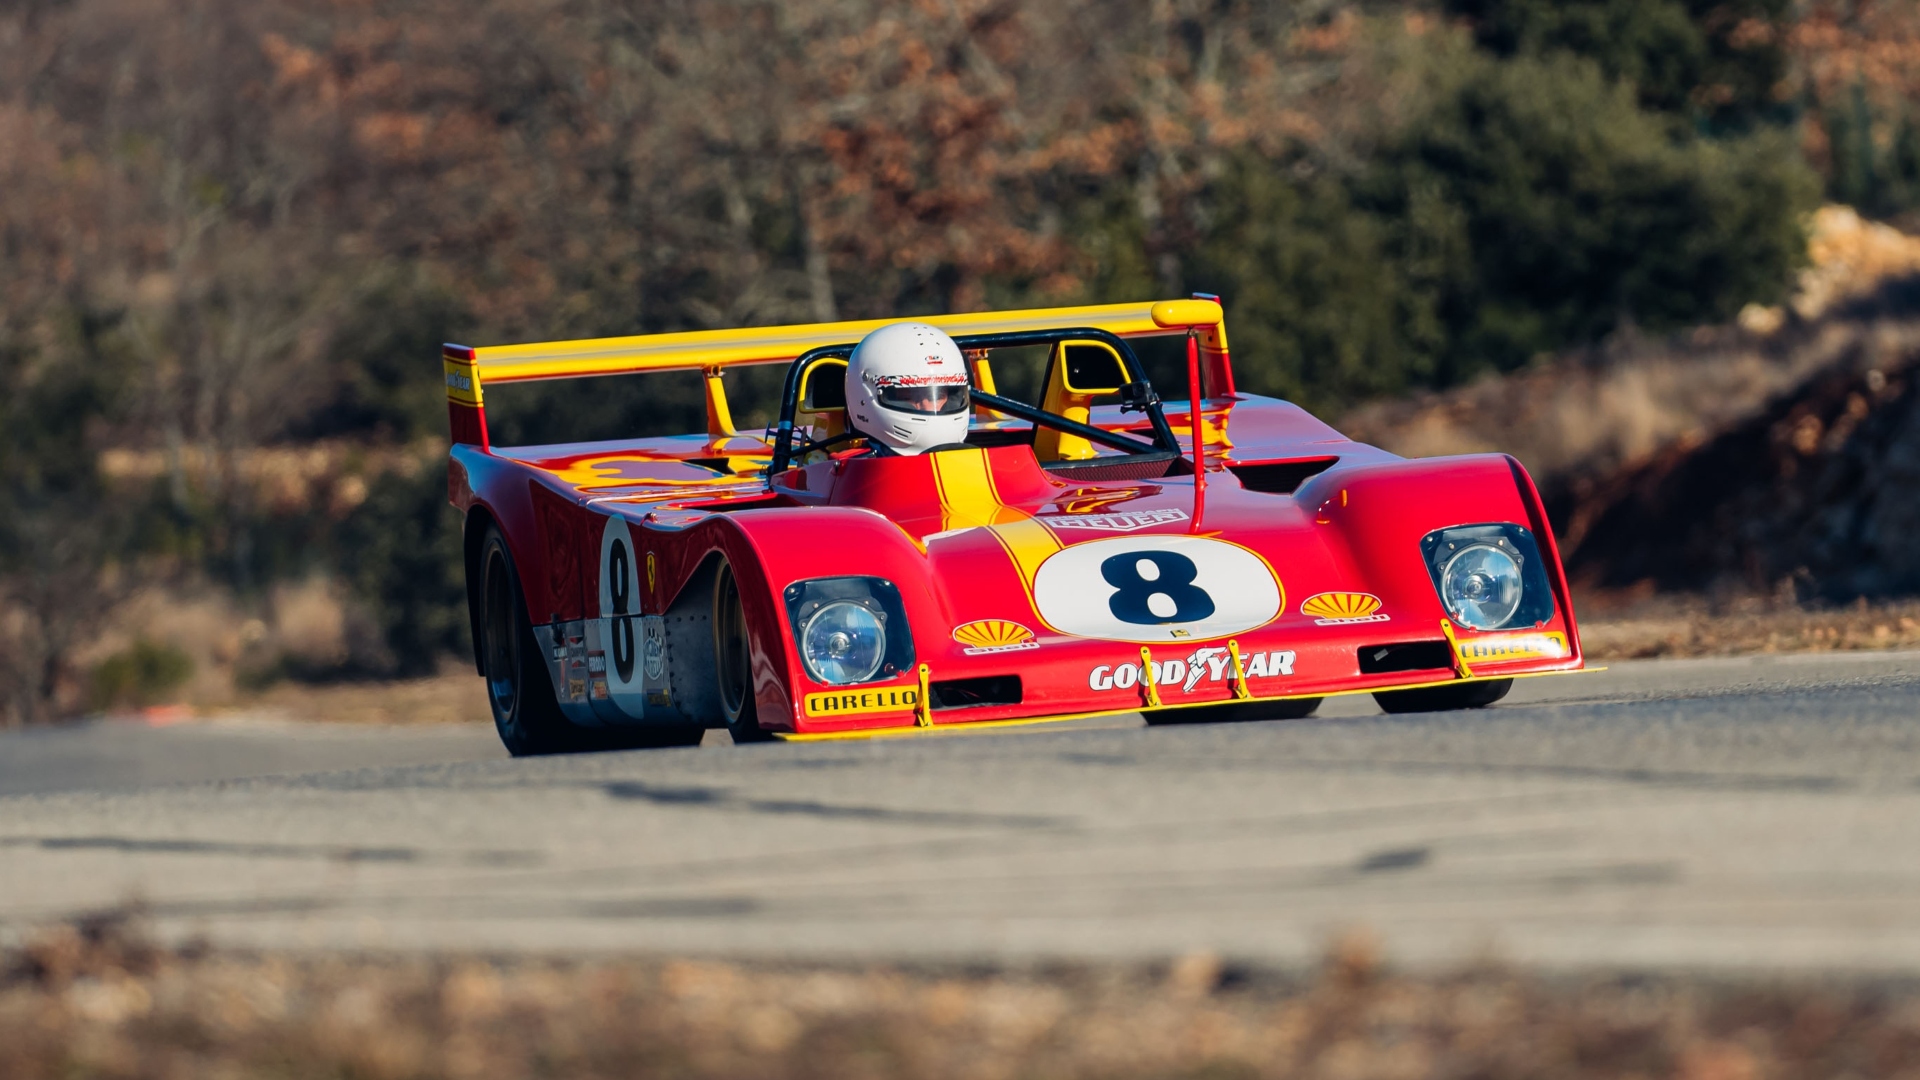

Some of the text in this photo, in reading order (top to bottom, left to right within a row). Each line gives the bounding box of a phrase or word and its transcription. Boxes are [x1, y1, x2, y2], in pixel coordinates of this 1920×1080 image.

[1059, 511, 1178, 529] HEUER
[1100, 550, 1216, 625] 8
[609, 538, 635, 684] 8
[1318, 615, 1387, 624] Shell
[967, 643, 1037, 653] Shell
[1088, 650, 1296, 692] GOOD YEAR
[810, 690, 917, 712] CARELLO
